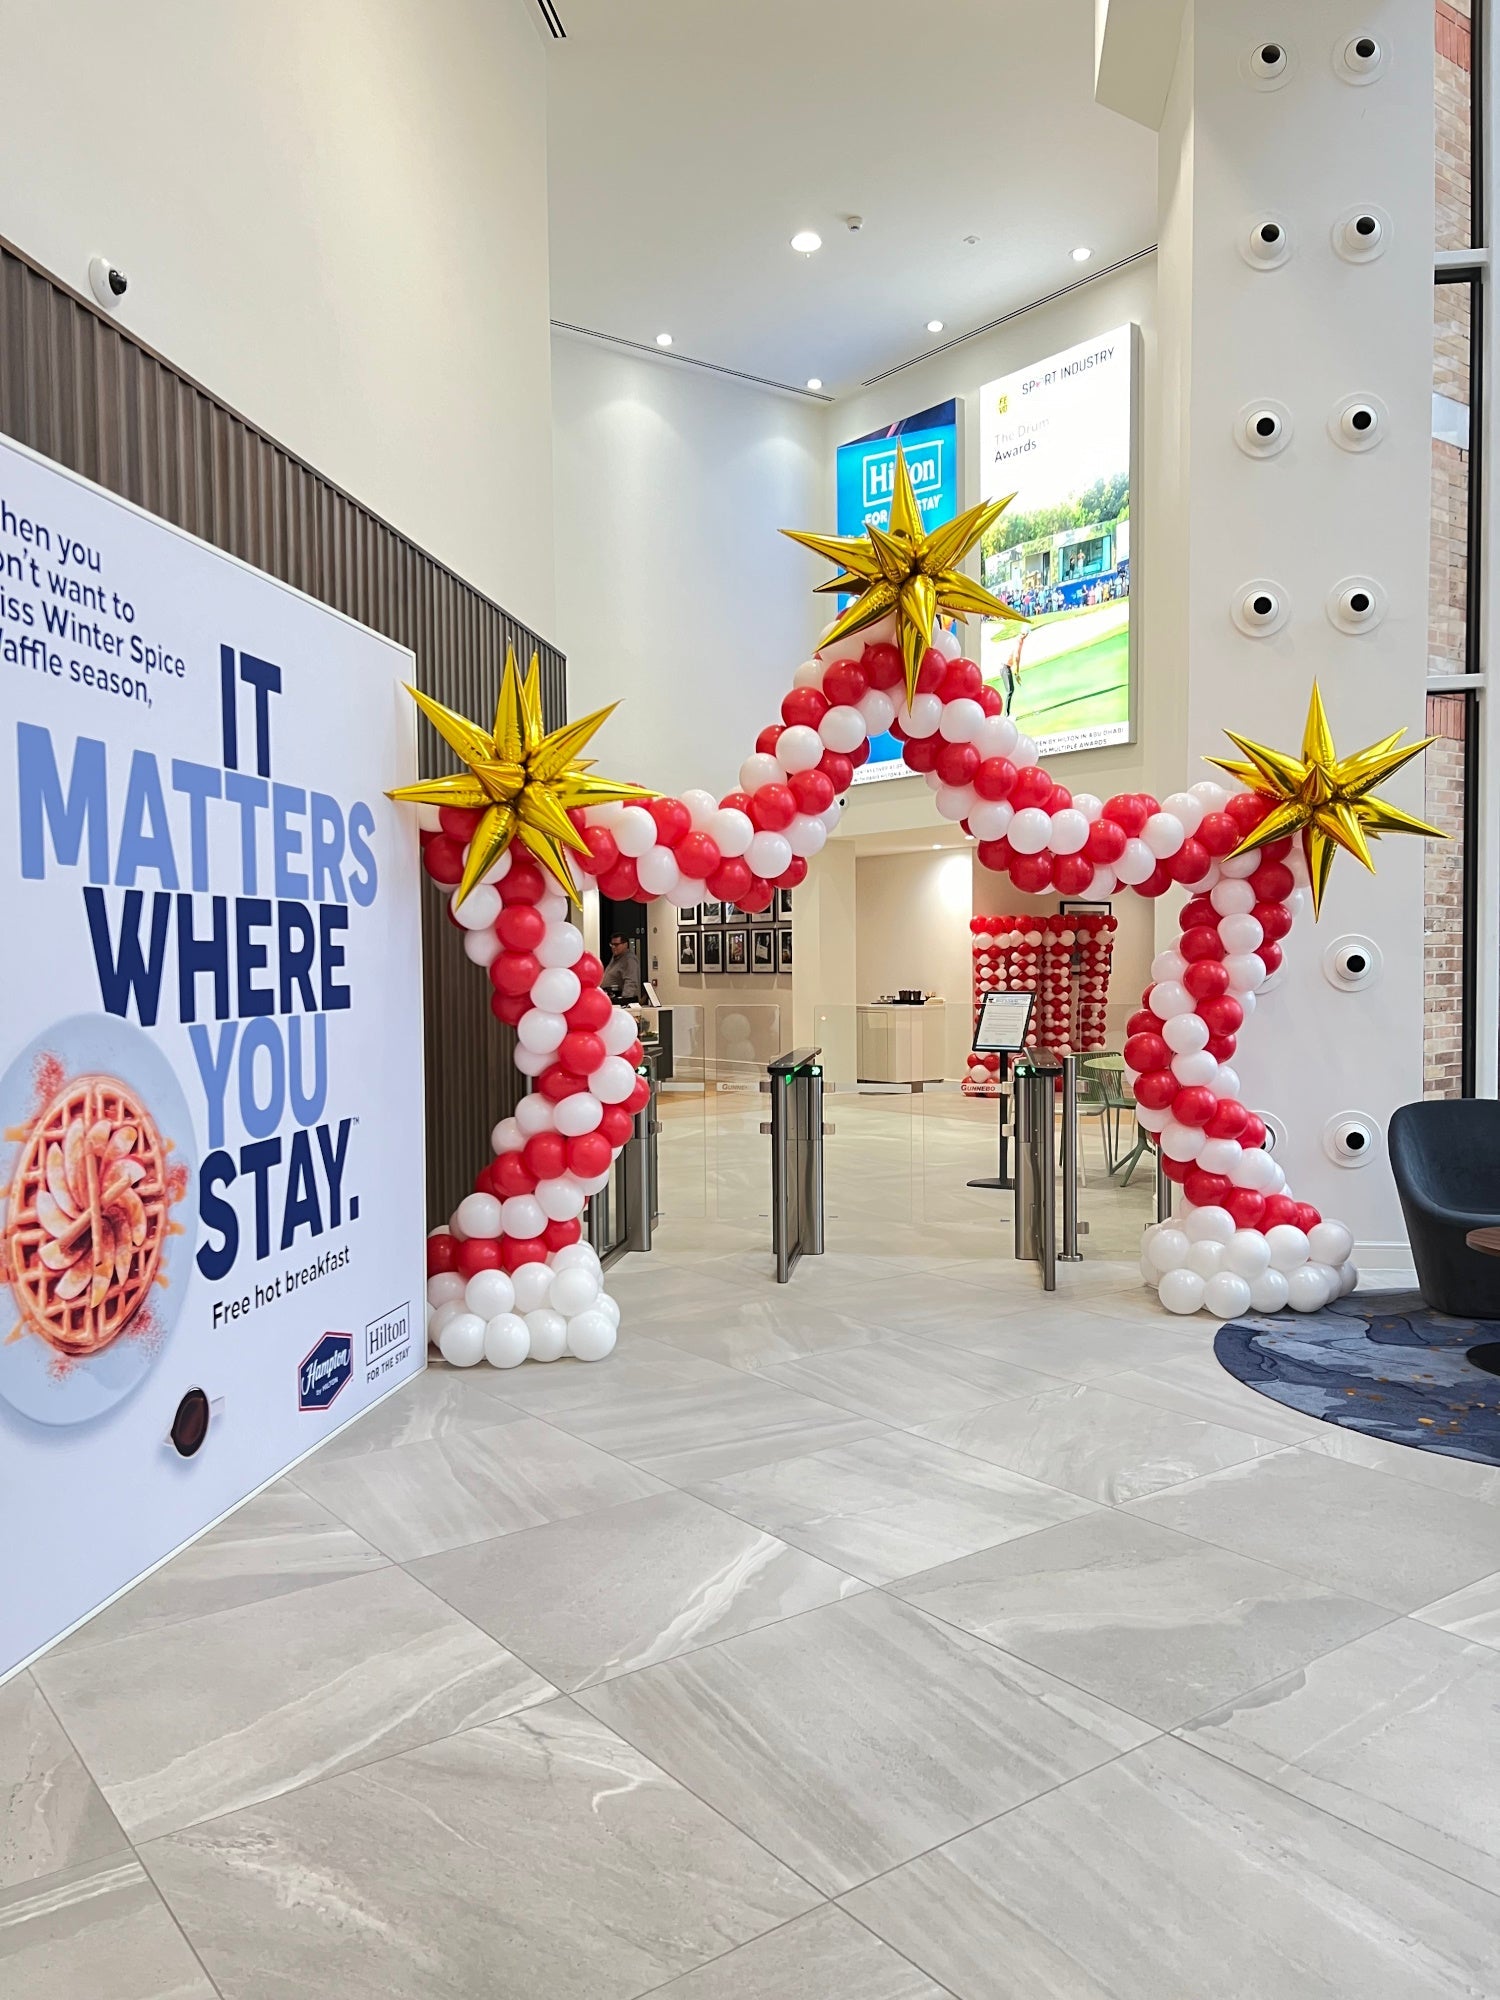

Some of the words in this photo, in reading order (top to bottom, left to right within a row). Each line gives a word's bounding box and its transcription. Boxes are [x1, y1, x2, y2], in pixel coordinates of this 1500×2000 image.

[1060, 346, 1115, 380] INDUSTRY
[869, 459, 936, 495] Hion
[994, 439, 1037, 463] Awards
[0, 499, 50, 551] hen
[57, 533, 101, 573] you
[48, 570, 107, 614] want
[113, 592, 135, 624] to
[0, 586, 34, 627] iss
[41, 600, 124, 657] Winter
[130, 634, 186, 678] Spice
[0, 628, 62, 677] affle
[69, 658, 153, 710] season,
[220, 642, 282, 779] IT
[1079, 738, 1107, 749] AWARDS
[16, 720, 378, 907] MATTERS
[82, 886, 352, 1027] WHERE
[188, 1013, 328, 1150] YOU
[960, 1084, 996, 1092] GUNNEBO
[196, 1118, 360, 1282] STAY.
[212, 1296, 250, 1329] Free
[255, 1277, 282, 1309] hot
[286, 1245, 350, 1292] breakfast
[369, 1318, 407, 1356] Hilton
[301, 1348, 351, 1396] Hampton
[366, 1368, 380, 1384] FOR
[382, 1357, 394, 1374] THE
